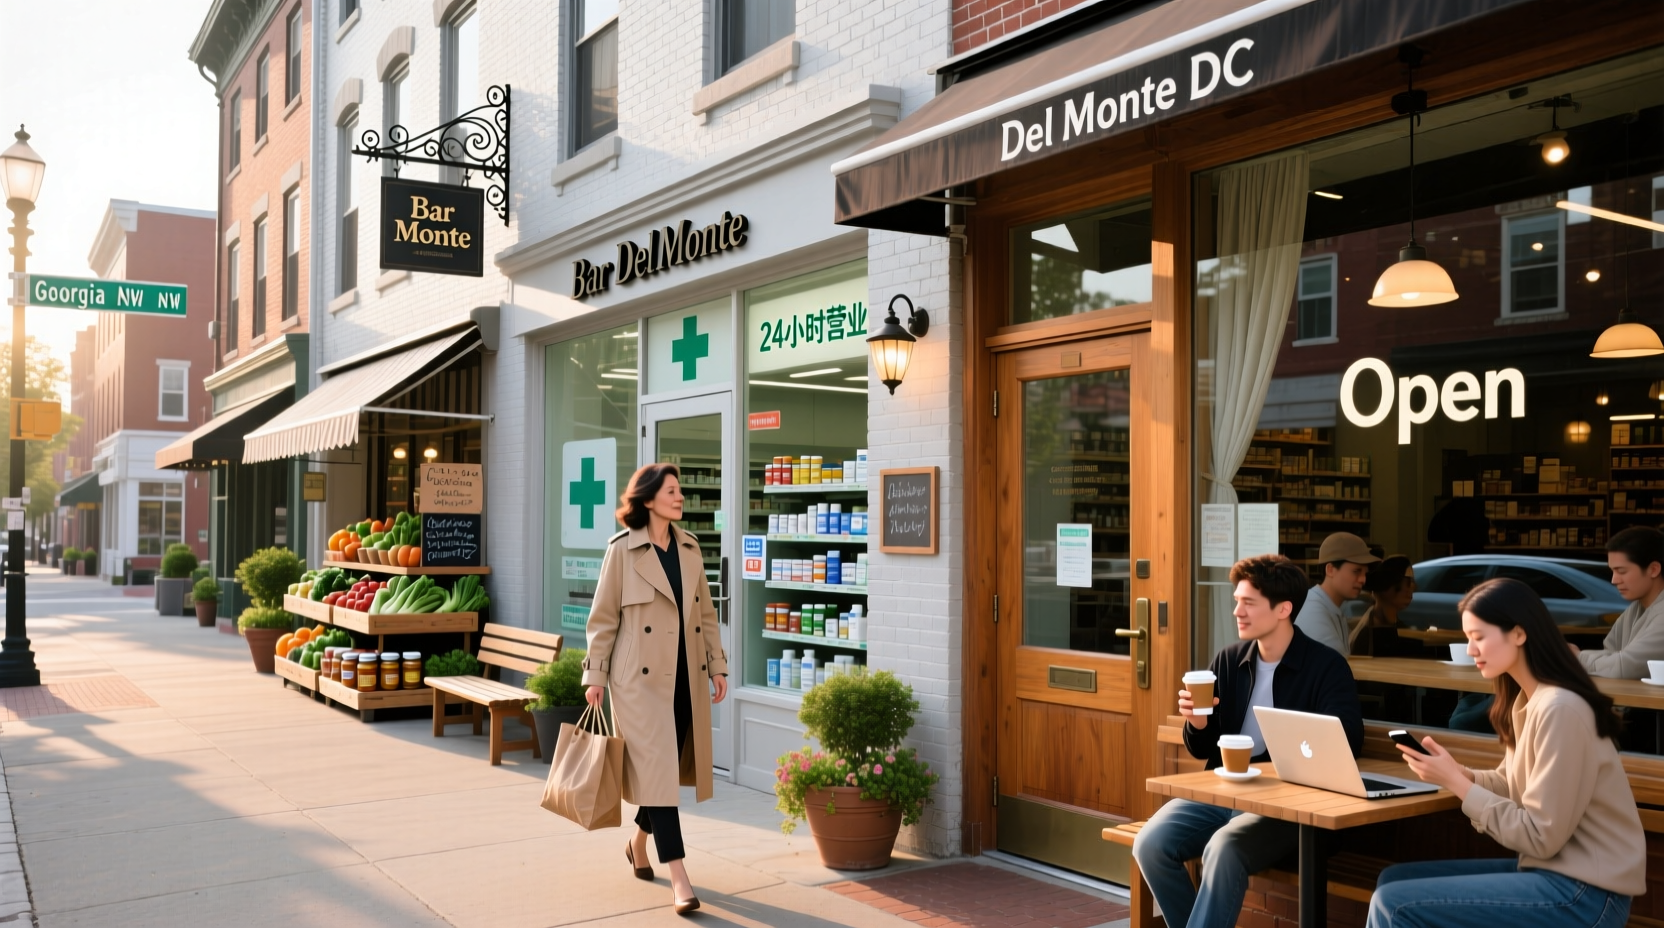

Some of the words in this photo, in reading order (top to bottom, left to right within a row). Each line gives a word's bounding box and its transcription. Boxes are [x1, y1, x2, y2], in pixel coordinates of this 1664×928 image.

[1001, 106, 1053, 162] Del
[1062, 76, 1177, 142] Monte
[1190, 38, 1255, 101] DC
[410, 195, 456, 222] Bar
[393, 219, 471, 249] Monte
[571, 258, 615, 300] Bar
[158, 291, 181, 310] NW
[759, 301, 868, 353] 24小时营业
[1340, 357, 1525, 445] Open
